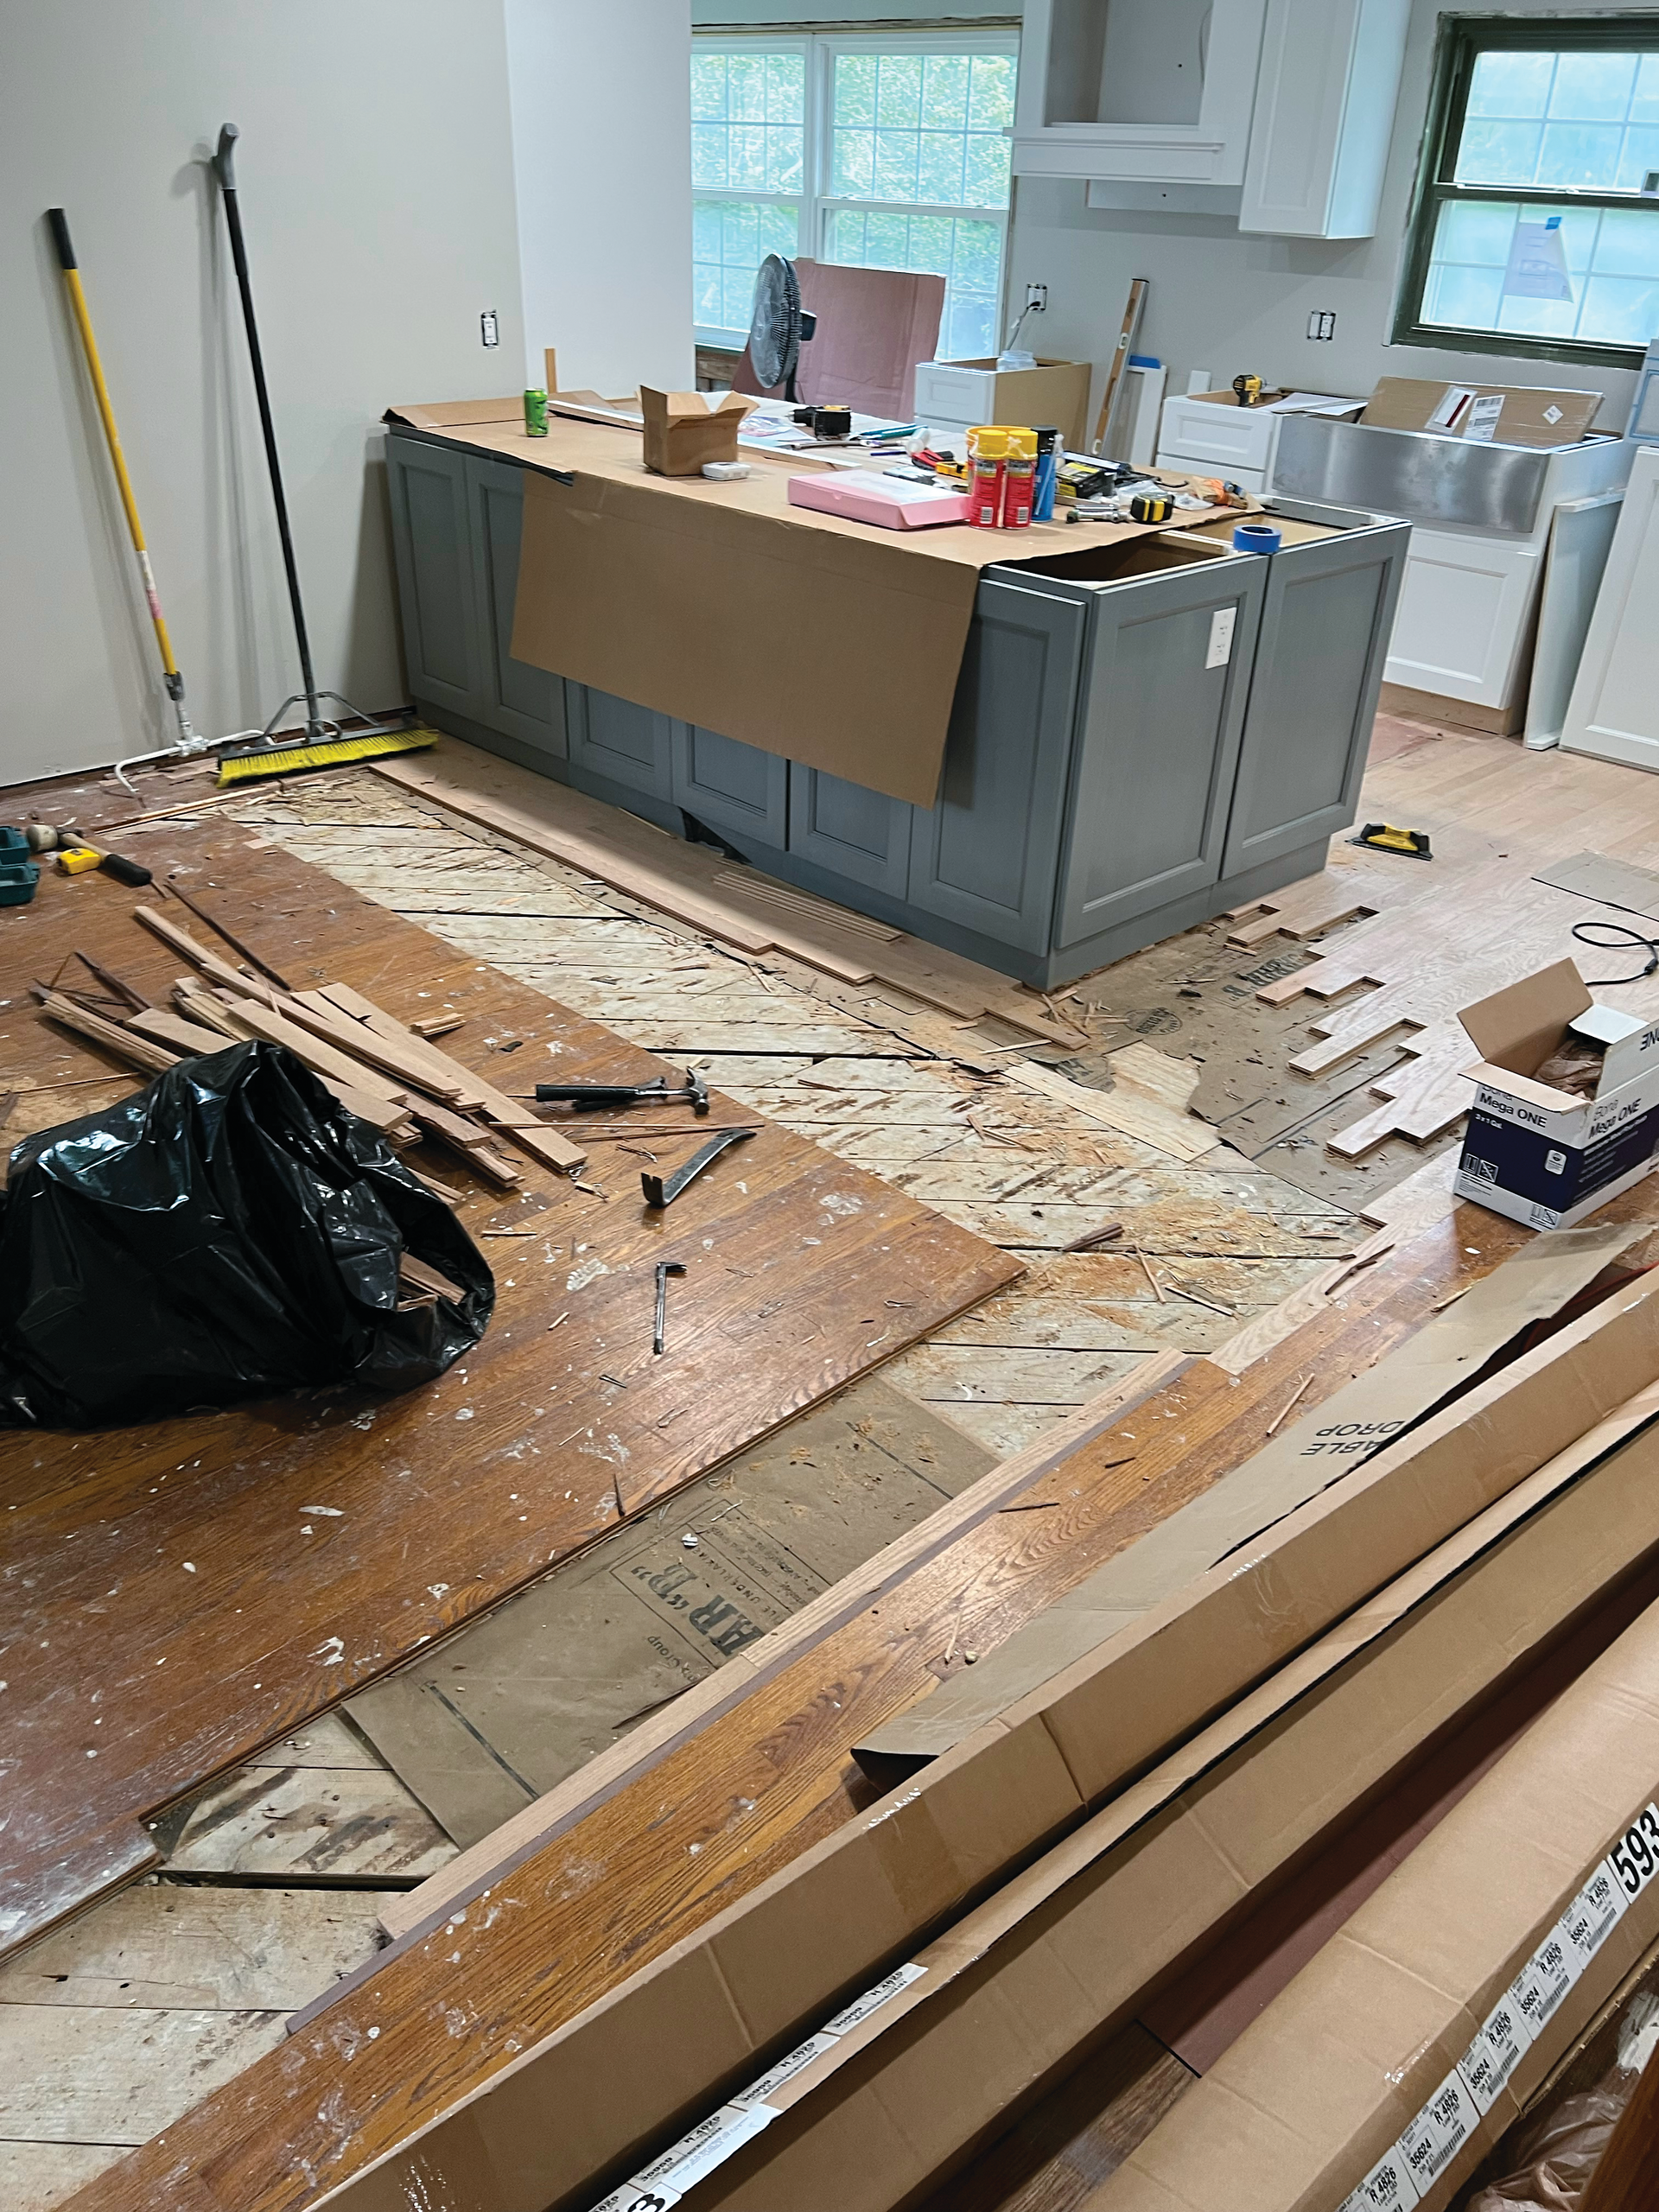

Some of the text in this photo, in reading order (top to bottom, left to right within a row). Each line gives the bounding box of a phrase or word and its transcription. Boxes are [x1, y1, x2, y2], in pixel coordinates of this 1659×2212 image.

[1479, 1092, 1548, 1128] Mega ONE
[1588, 1116, 1617, 1139] Mega
[1618, 1098, 1642, 1121] ONE
[1316, 1421, 1405, 1436] DROP
[647, 1636, 681, 1668] Group
[1611, 1810, 1659, 1893] 593
[1495, 2012, 1511, 2036] 4826
[1470, 2058, 1491, 2089] 35624
[1441, 2089, 1459, 2114] 4826
[1409, 2137, 1432, 2169] 35624
[1370, 2167, 1396, 2203] R 4826
